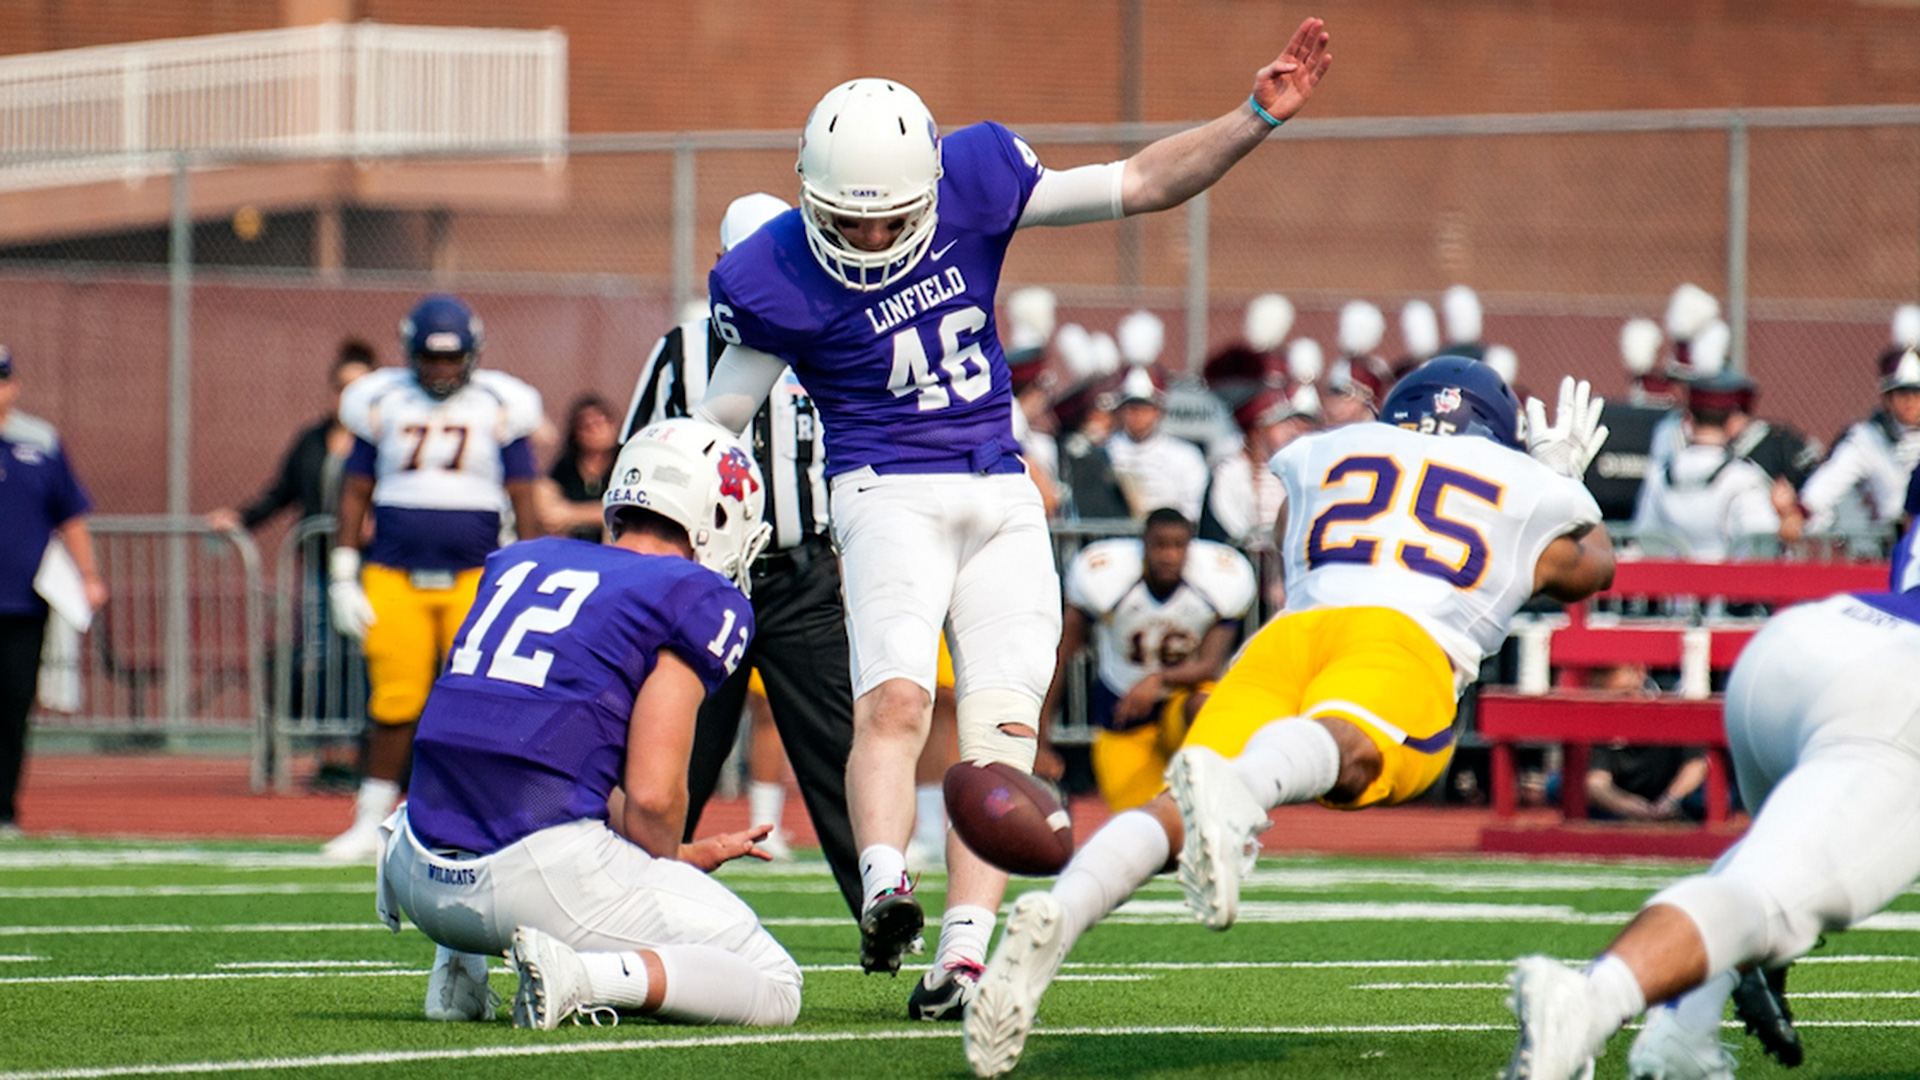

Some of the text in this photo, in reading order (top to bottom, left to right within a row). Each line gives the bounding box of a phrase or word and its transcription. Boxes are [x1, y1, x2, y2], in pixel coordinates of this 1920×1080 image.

[865, 266, 966, 334] LINFIELD
[886, 306, 991, 411] 46
[402, 425, 470, 472] 77
[1306, 455, 1506, 591] 25
[451, 561, 600, 688] 12
